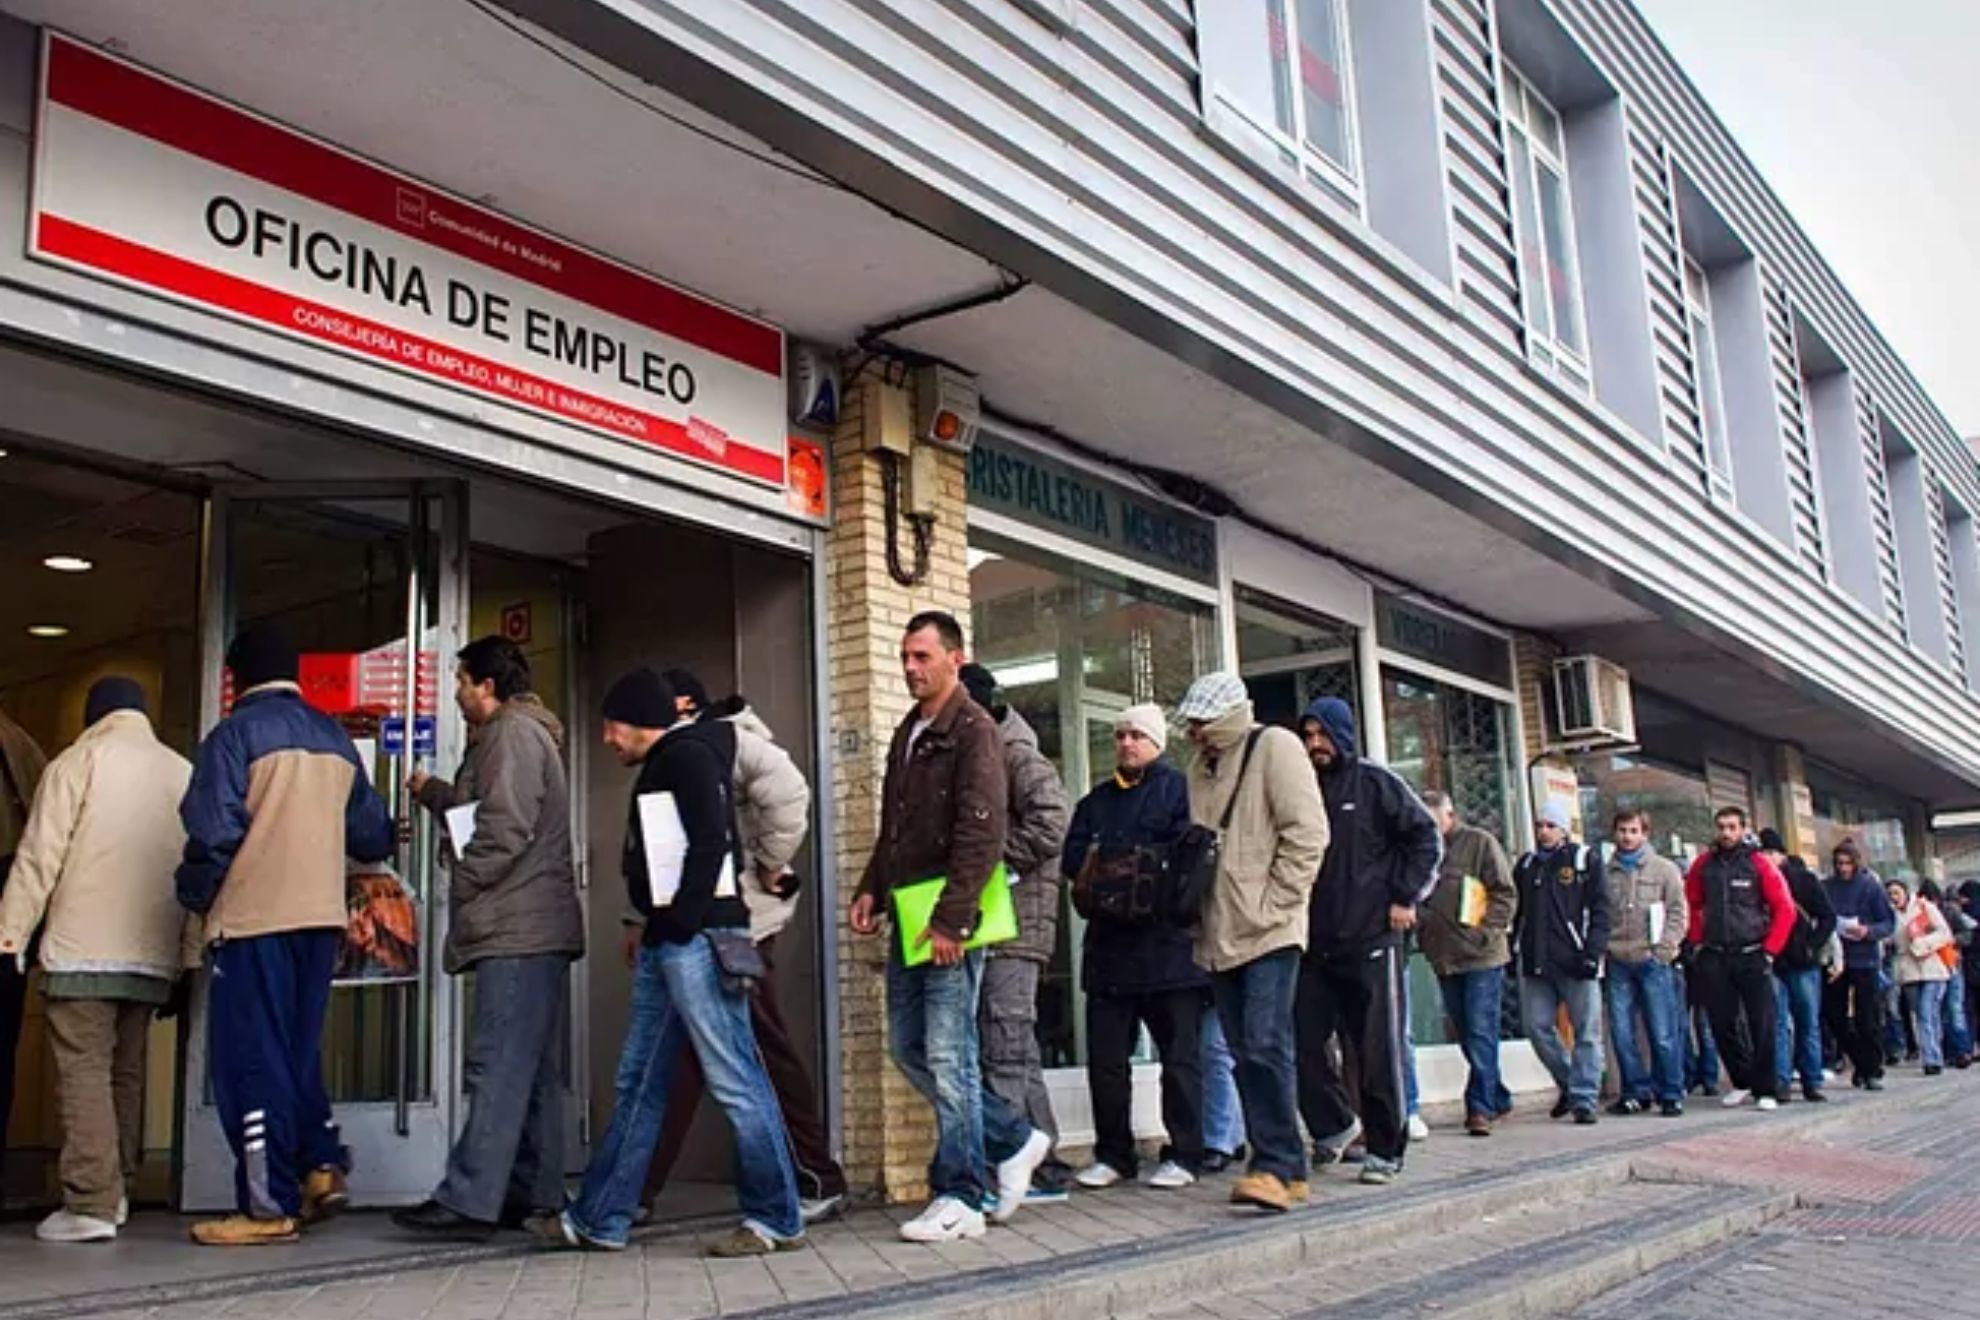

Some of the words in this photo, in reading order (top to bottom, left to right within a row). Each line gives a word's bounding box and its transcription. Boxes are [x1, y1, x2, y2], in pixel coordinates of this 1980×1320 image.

[428, 210, 498, 248] Comunidad
[502, 240, 517, 255] de
[520, 246, 563, 273] Madrid
[206, 196, 431, 315] OFICINA
[448, 279, 509, 342] DE
[525, 308, 696, 404] EMPLEO
[402, 342, 424, 362] DE
[495, 372, 544, 402] MUJER
[547, 388, 557, 407] E
[968, 443, 1110, 539] RISTALERIA
